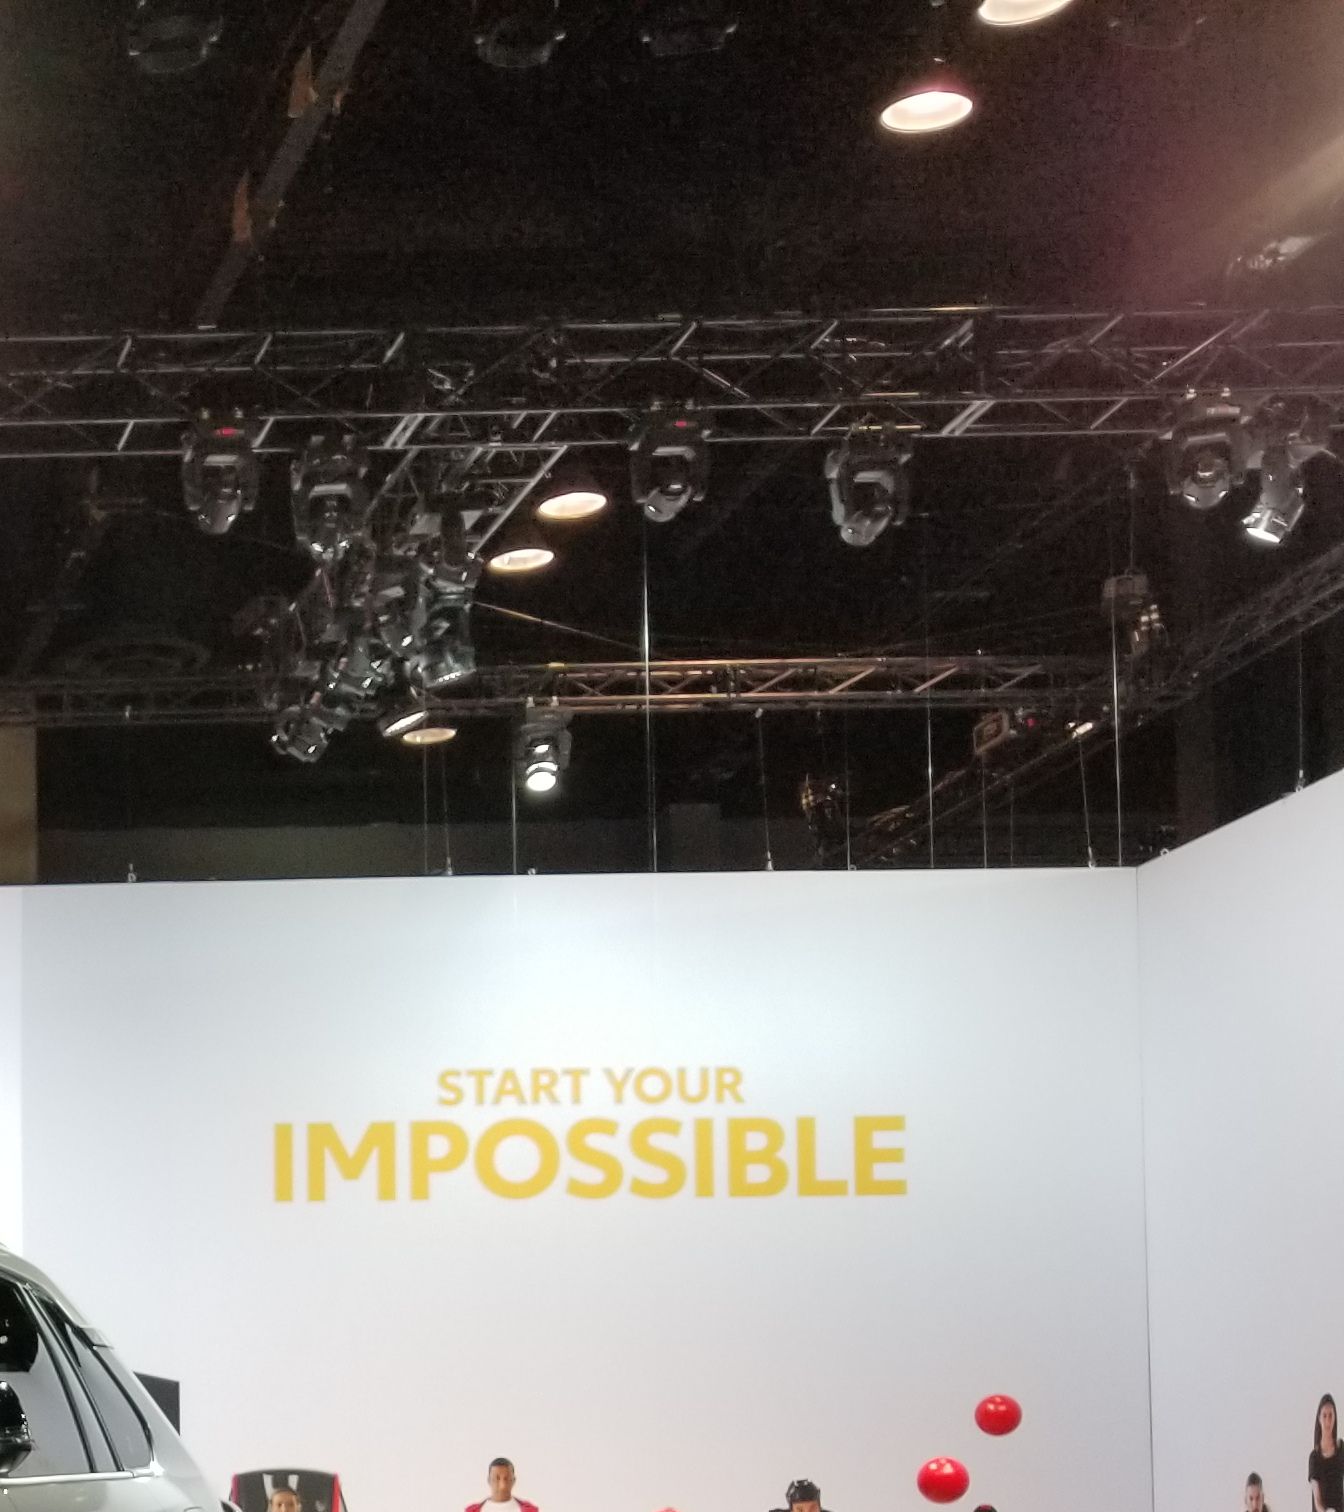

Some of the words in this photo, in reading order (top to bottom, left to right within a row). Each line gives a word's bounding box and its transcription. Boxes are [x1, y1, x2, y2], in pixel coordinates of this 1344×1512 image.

[437, 1067, 590, 1106] START
[603, 1066, 745, 1104] YOUR
[274, 1115, 908, 1203] IMPOSSIBLE
